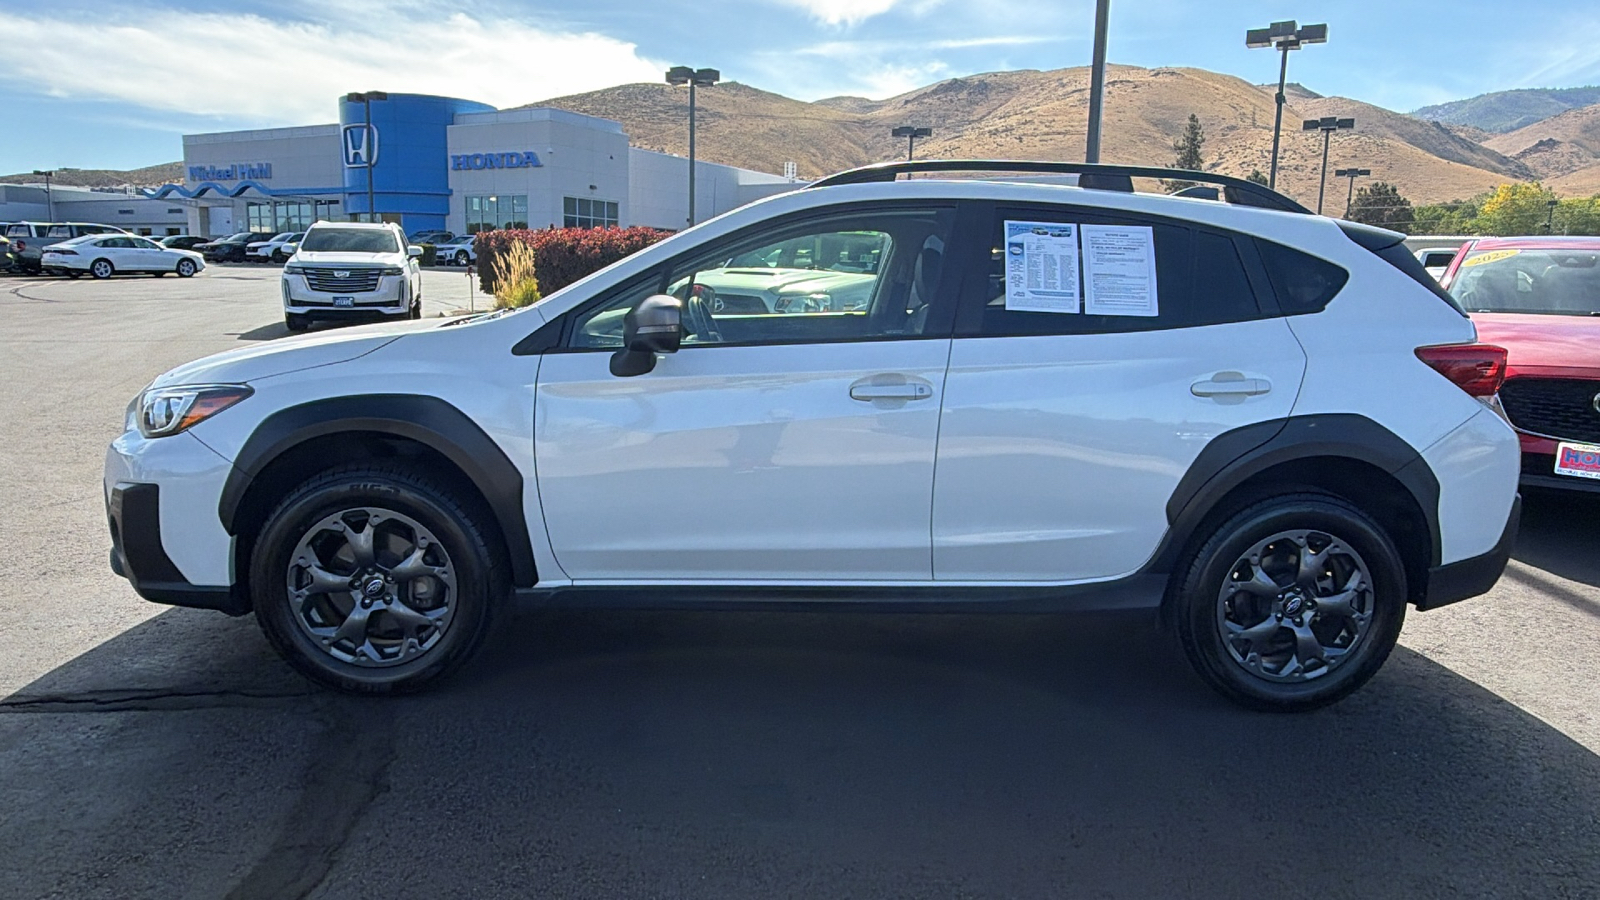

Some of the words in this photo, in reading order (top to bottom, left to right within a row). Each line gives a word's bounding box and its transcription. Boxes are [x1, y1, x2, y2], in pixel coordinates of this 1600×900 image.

[451, 151, 543, 170] HONDA
[189, 164, 238, 181] Michael
[1474, 252, 1509, 264] 2025
